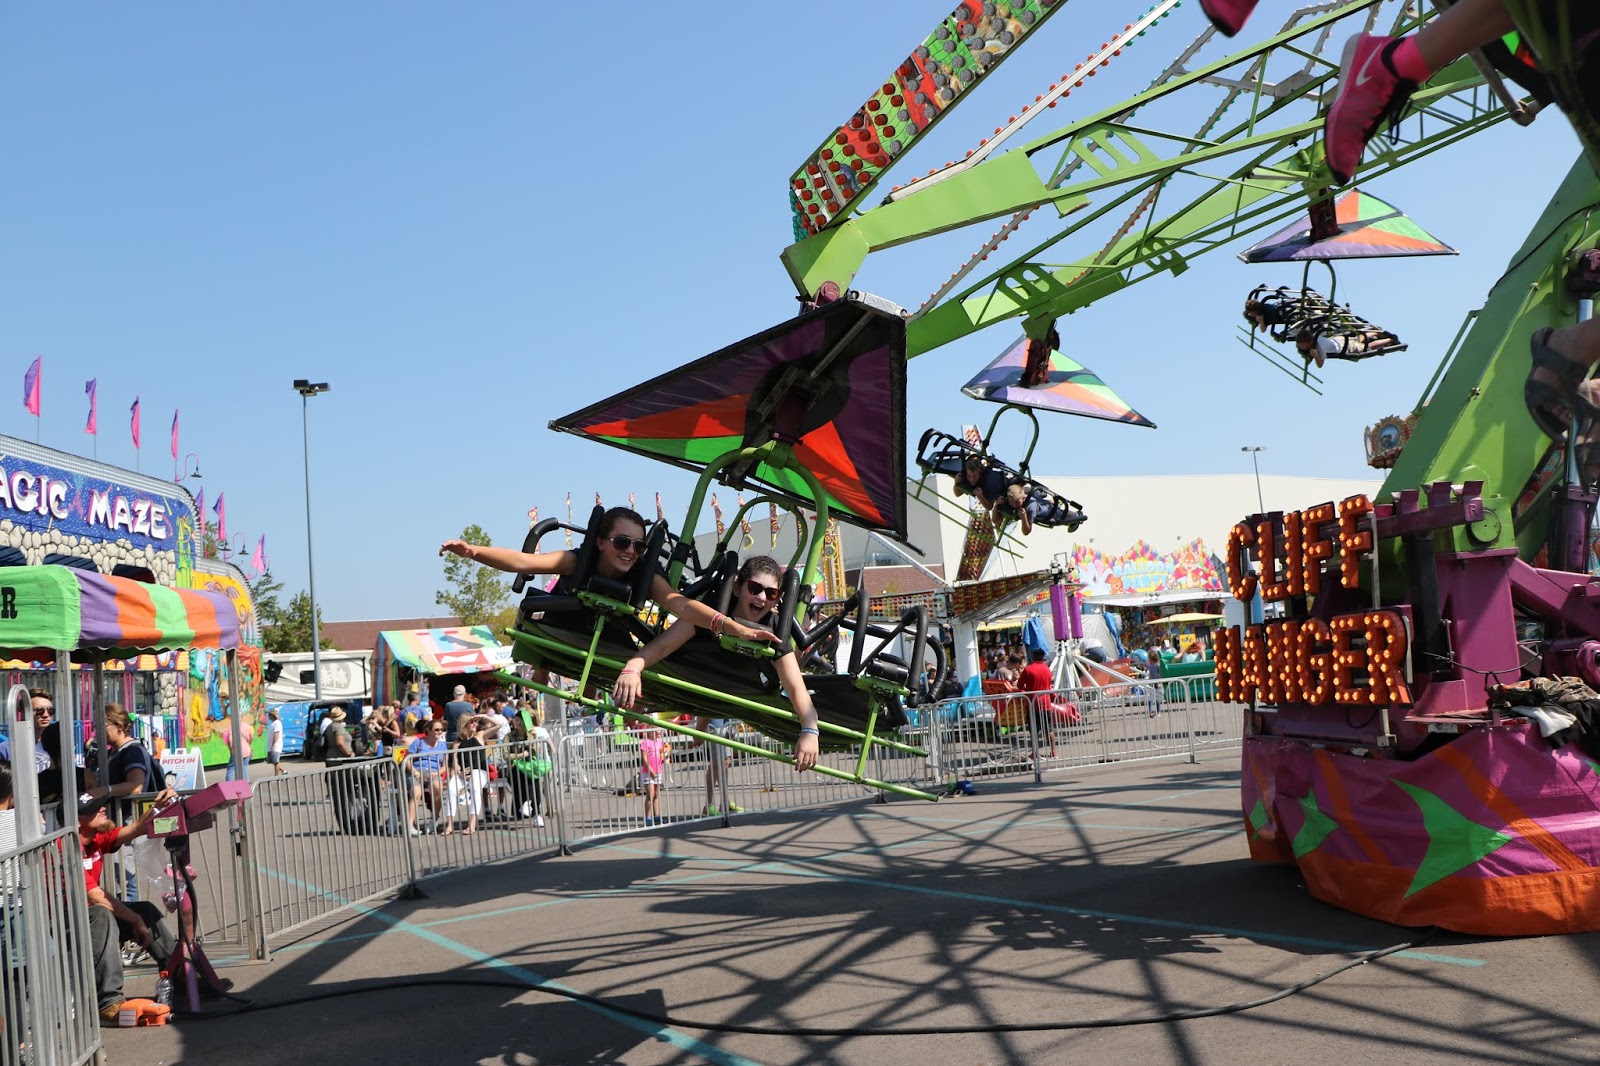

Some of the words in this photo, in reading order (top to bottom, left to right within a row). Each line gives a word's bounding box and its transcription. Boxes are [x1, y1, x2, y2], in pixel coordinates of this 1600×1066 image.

[87, 488, 167, 540] MAZE
[1113, 556, 1174, 577] BALLOON
[1225, 494, 1373, 600] CLIFF
[1123, 574, 1168, 589] PARTY
[1211, 610, 1414, 705] HANGER
